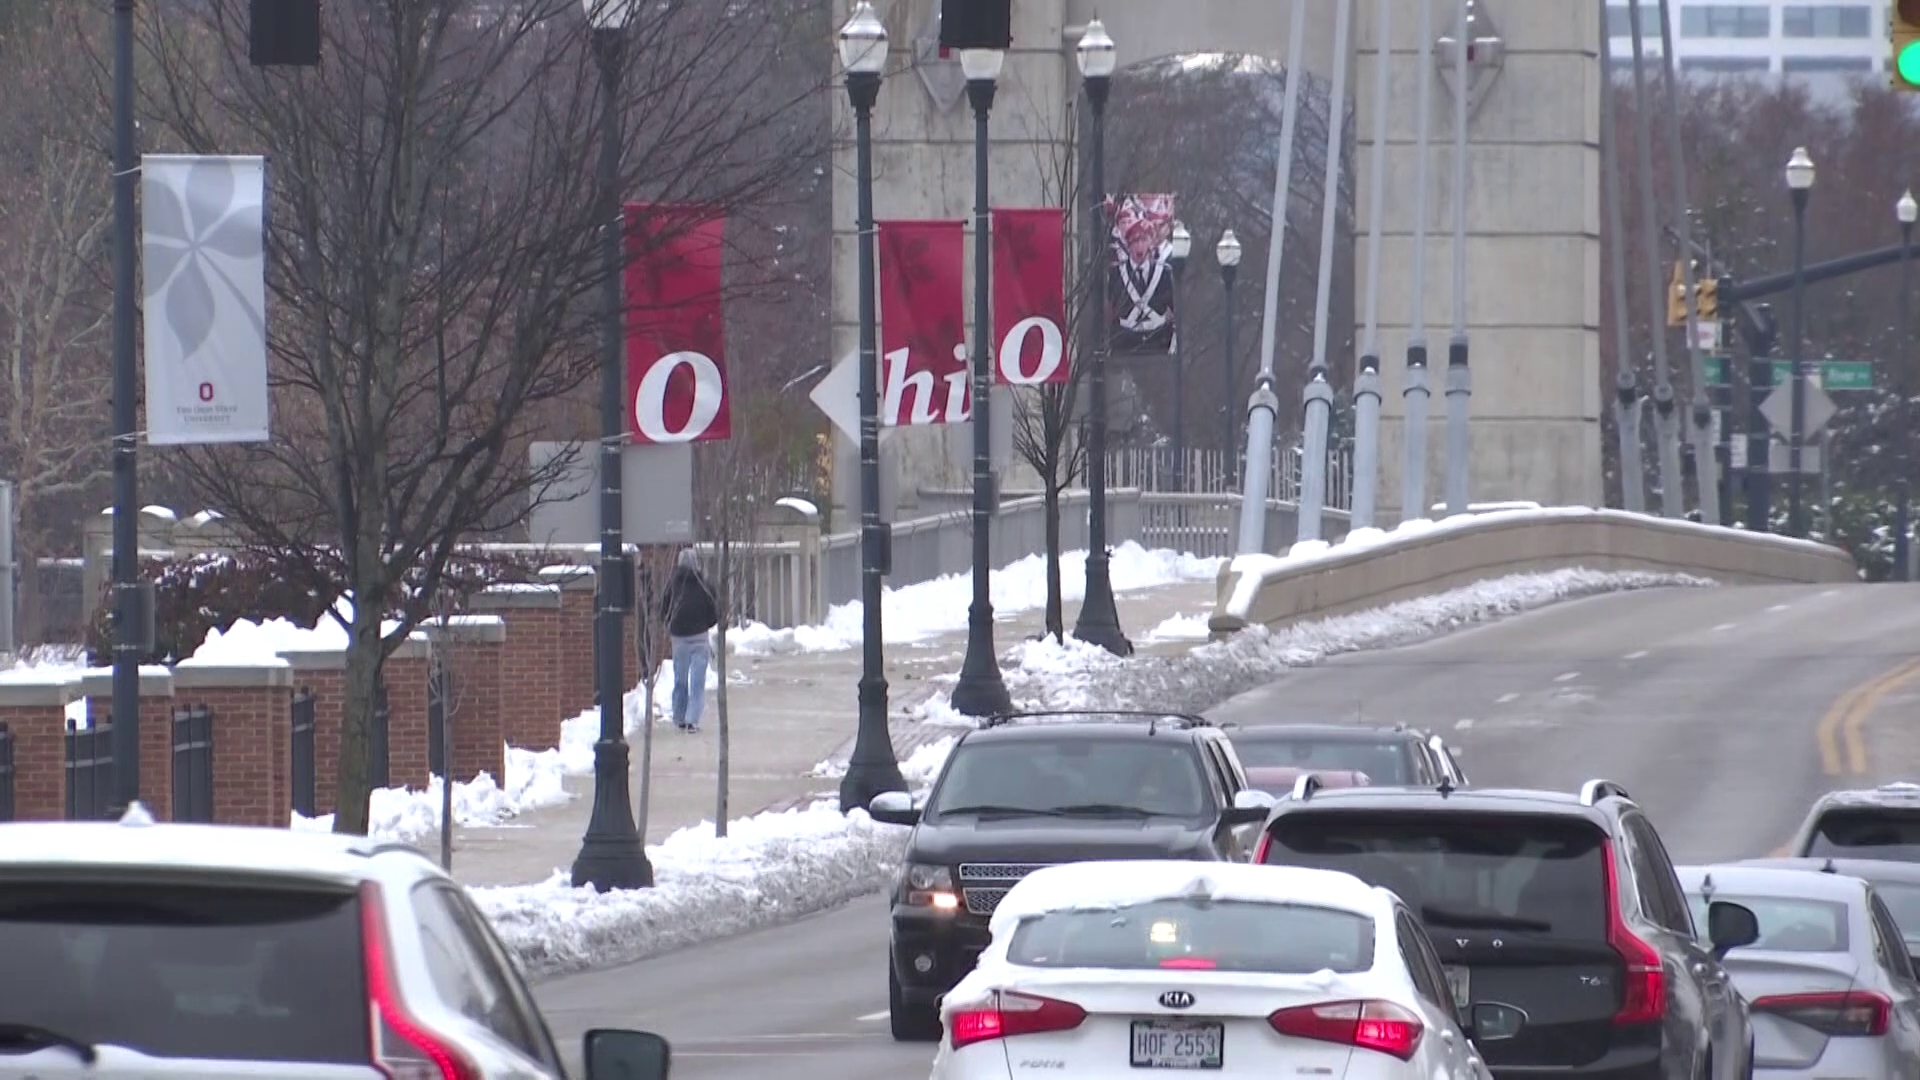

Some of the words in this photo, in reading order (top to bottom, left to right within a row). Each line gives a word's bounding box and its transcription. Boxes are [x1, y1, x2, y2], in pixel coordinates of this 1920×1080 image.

[884, 345, 970, 425] hi
[1163, 993, 1190, 1005] KIA
[1138, 1032, 1168, 1056] HOF
[1174, 1032, 1216, 1056] 2553
